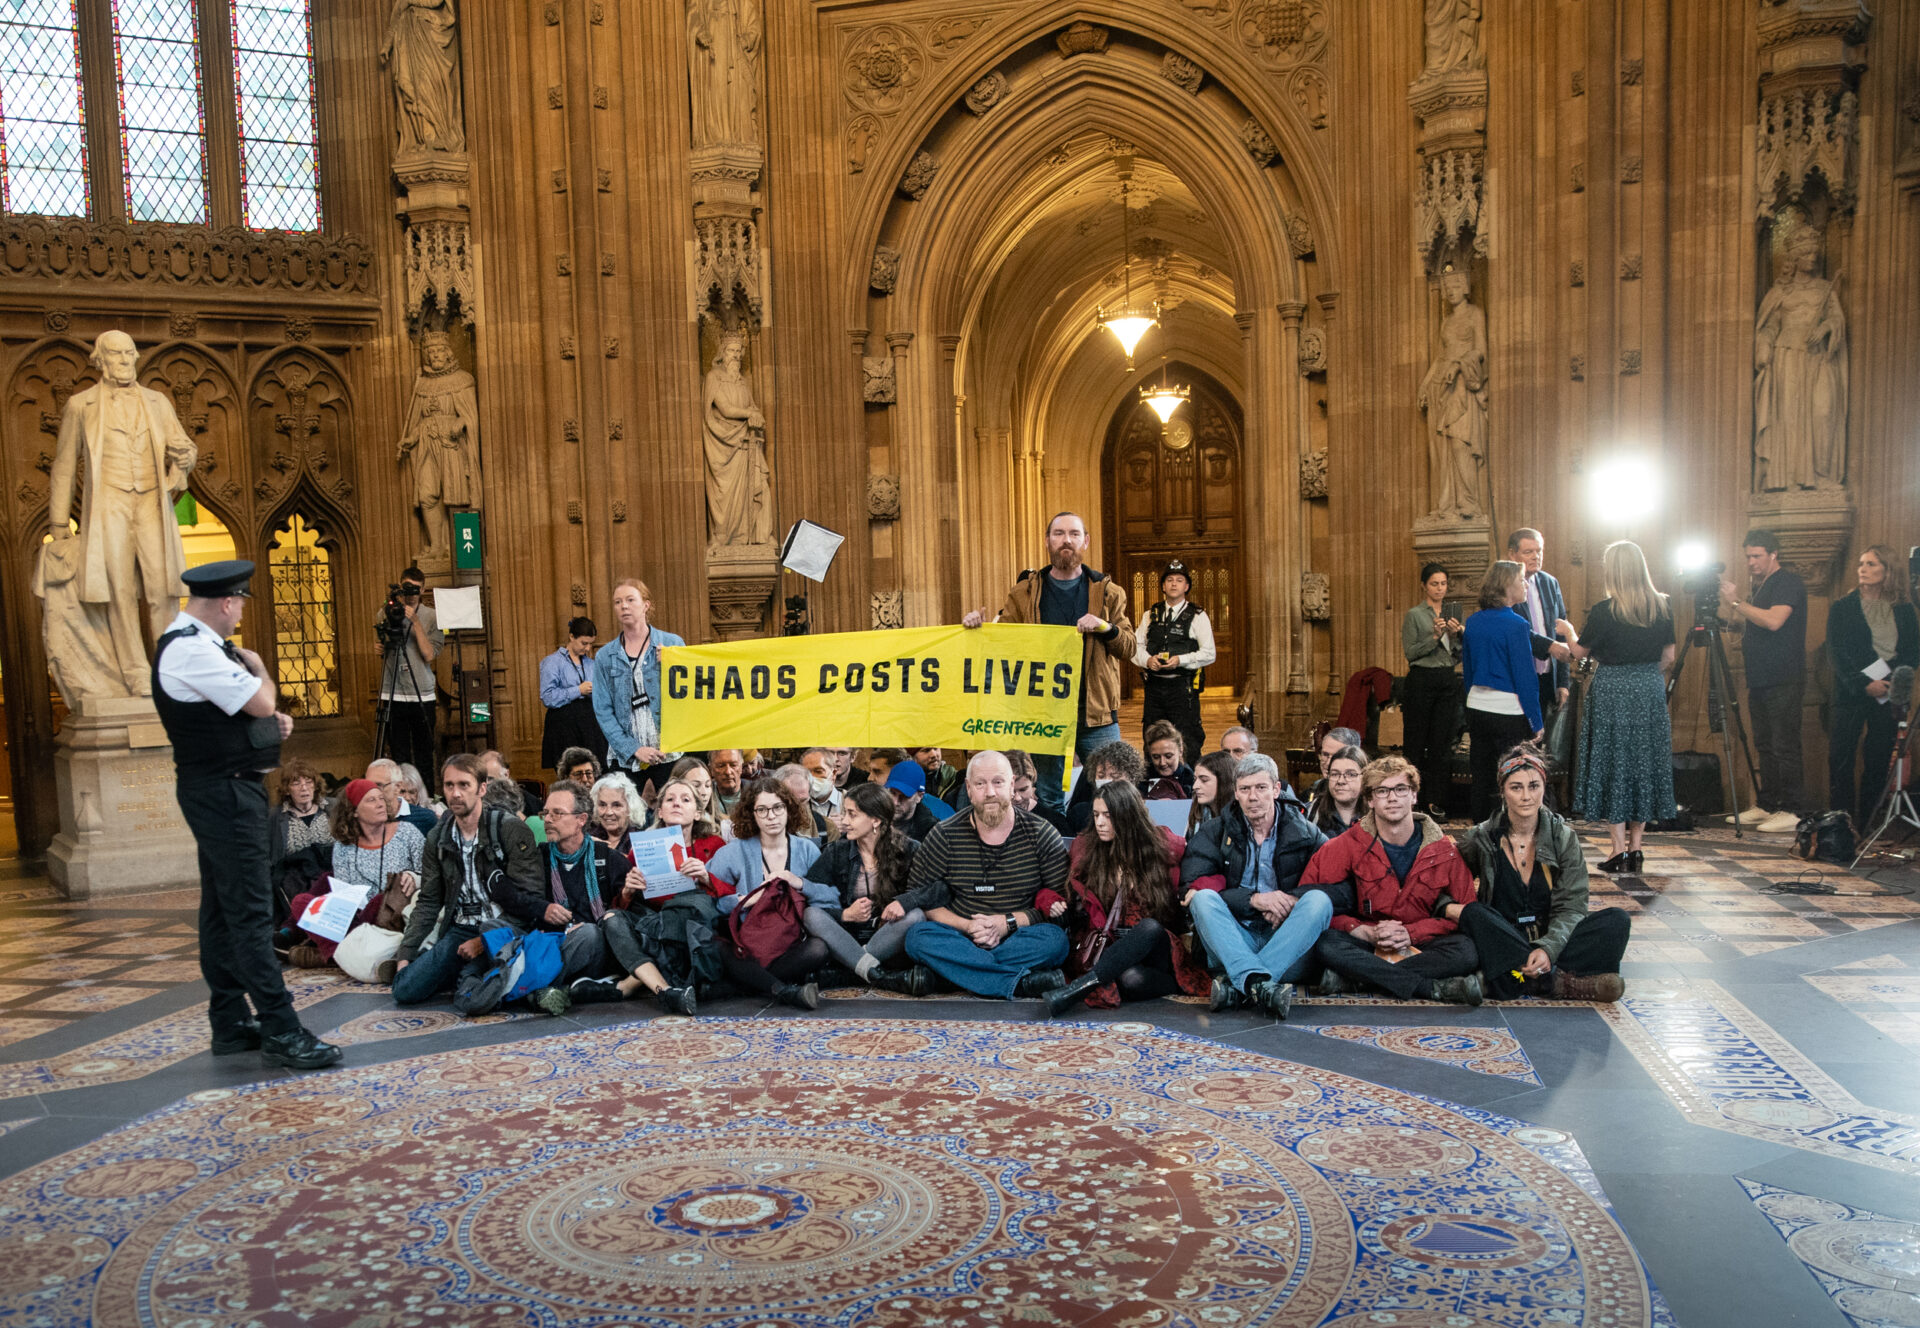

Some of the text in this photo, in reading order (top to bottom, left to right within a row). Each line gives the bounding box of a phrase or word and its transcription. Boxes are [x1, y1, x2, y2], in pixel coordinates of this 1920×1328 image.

[668, 657, 1073, 700] CHAOS COSTS LIVES
[962, 718, 1067, 738] GREENPEACE
